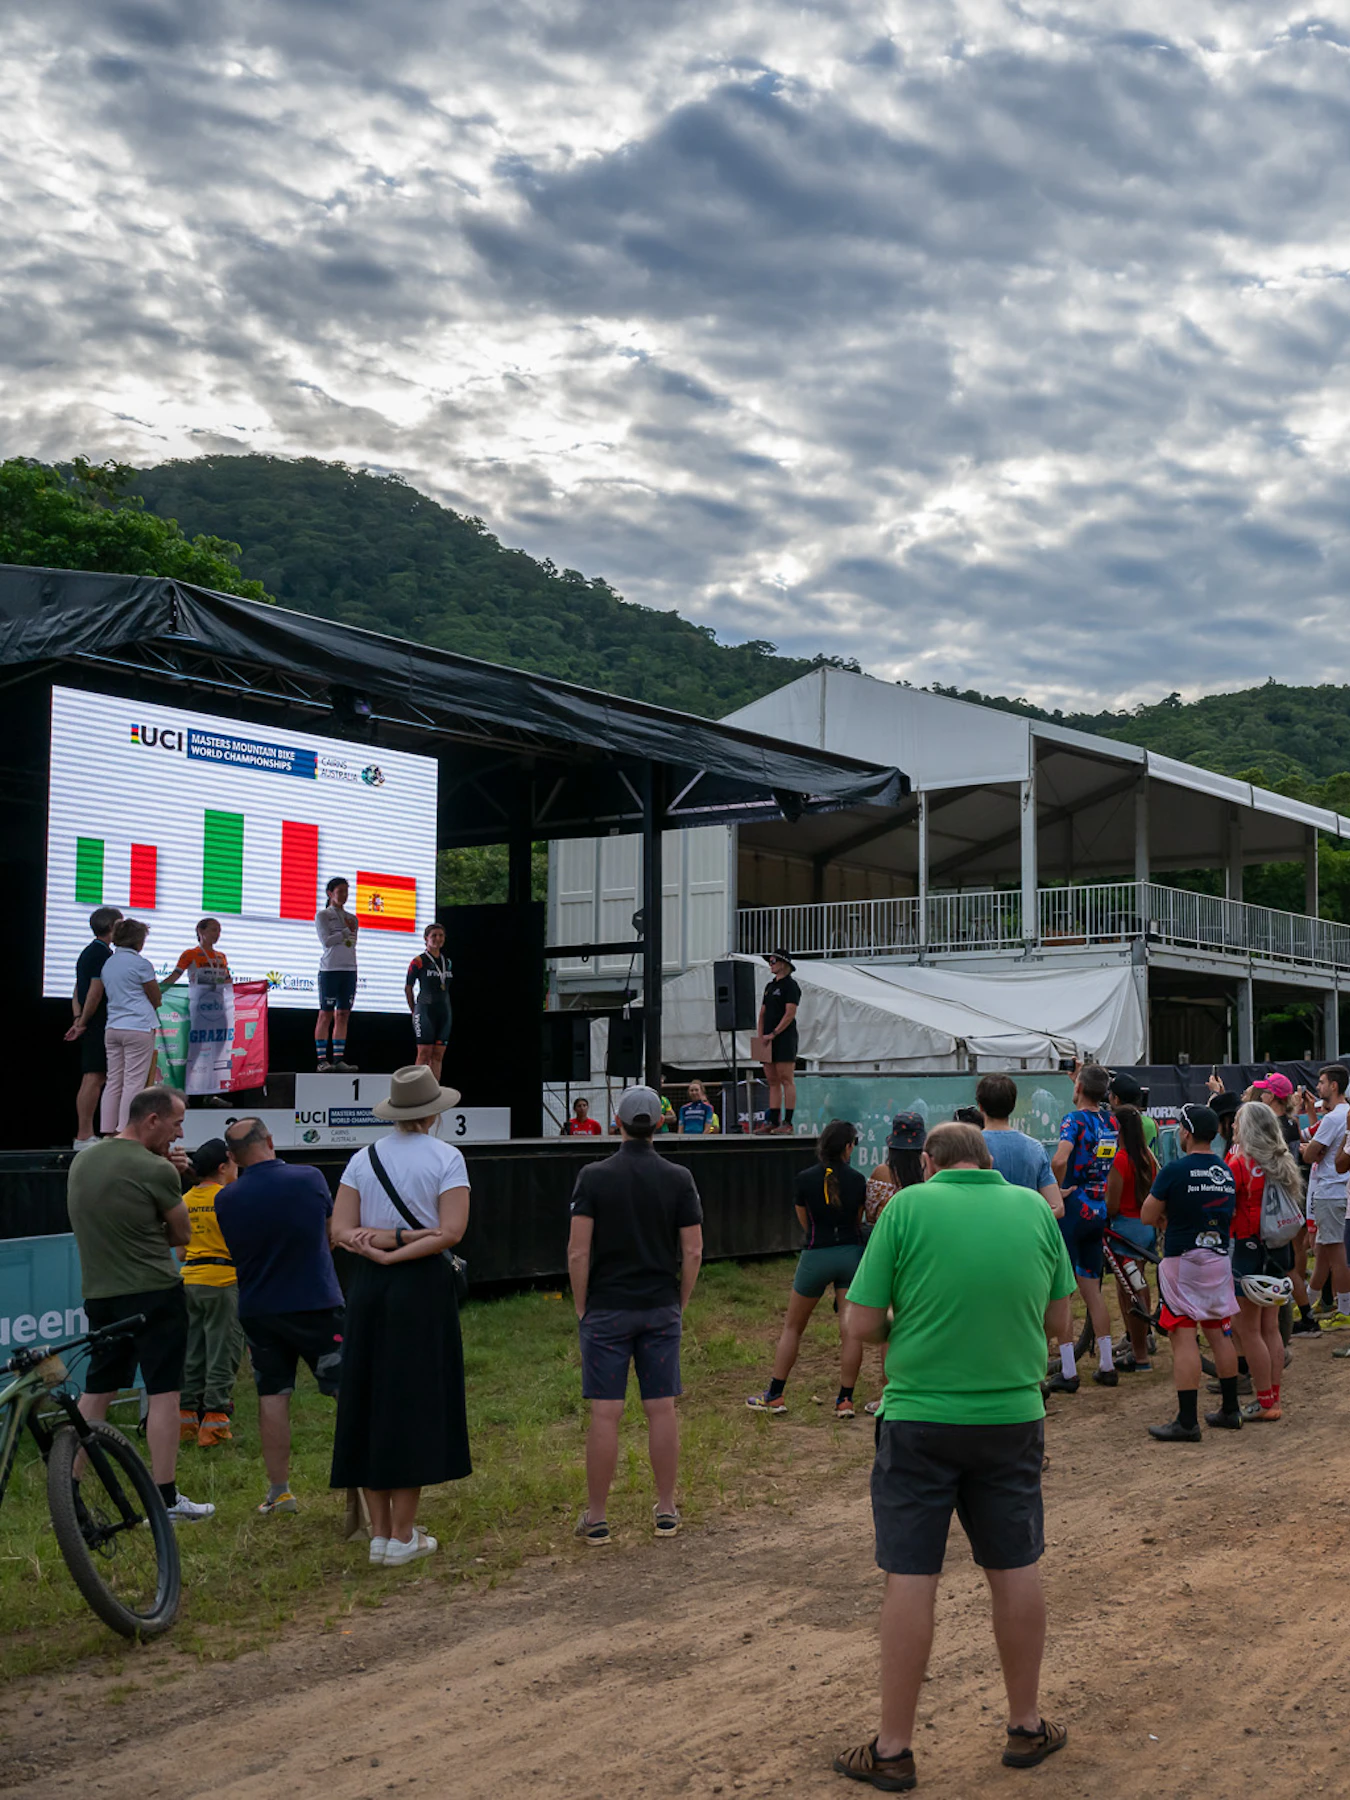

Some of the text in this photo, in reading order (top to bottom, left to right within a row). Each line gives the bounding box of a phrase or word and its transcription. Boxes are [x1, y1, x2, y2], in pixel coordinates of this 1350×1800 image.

[141, 725, 183, 751] UCI
[191, 734, 296, 761] MASTERS MOUNTAIN BIKE
[191, 745, 293, 771] WORLD CHAMPIONSHIPS
[321, 757, 348, 769] CAIRNS
[321, 769, 358, 782] AUSTRALIA
[282, 974, 315, 987] Cairns
[190, 1028, 234, 1043] GRAZIE
[352, 1078, 360, 1101] 1
[301, 1111, 326, 1124] UCI
[330, 1109, 356, 1117] MASTERS
[455, 1115, 467, 1136] 3
[867, 1128, 876, 1142] &
